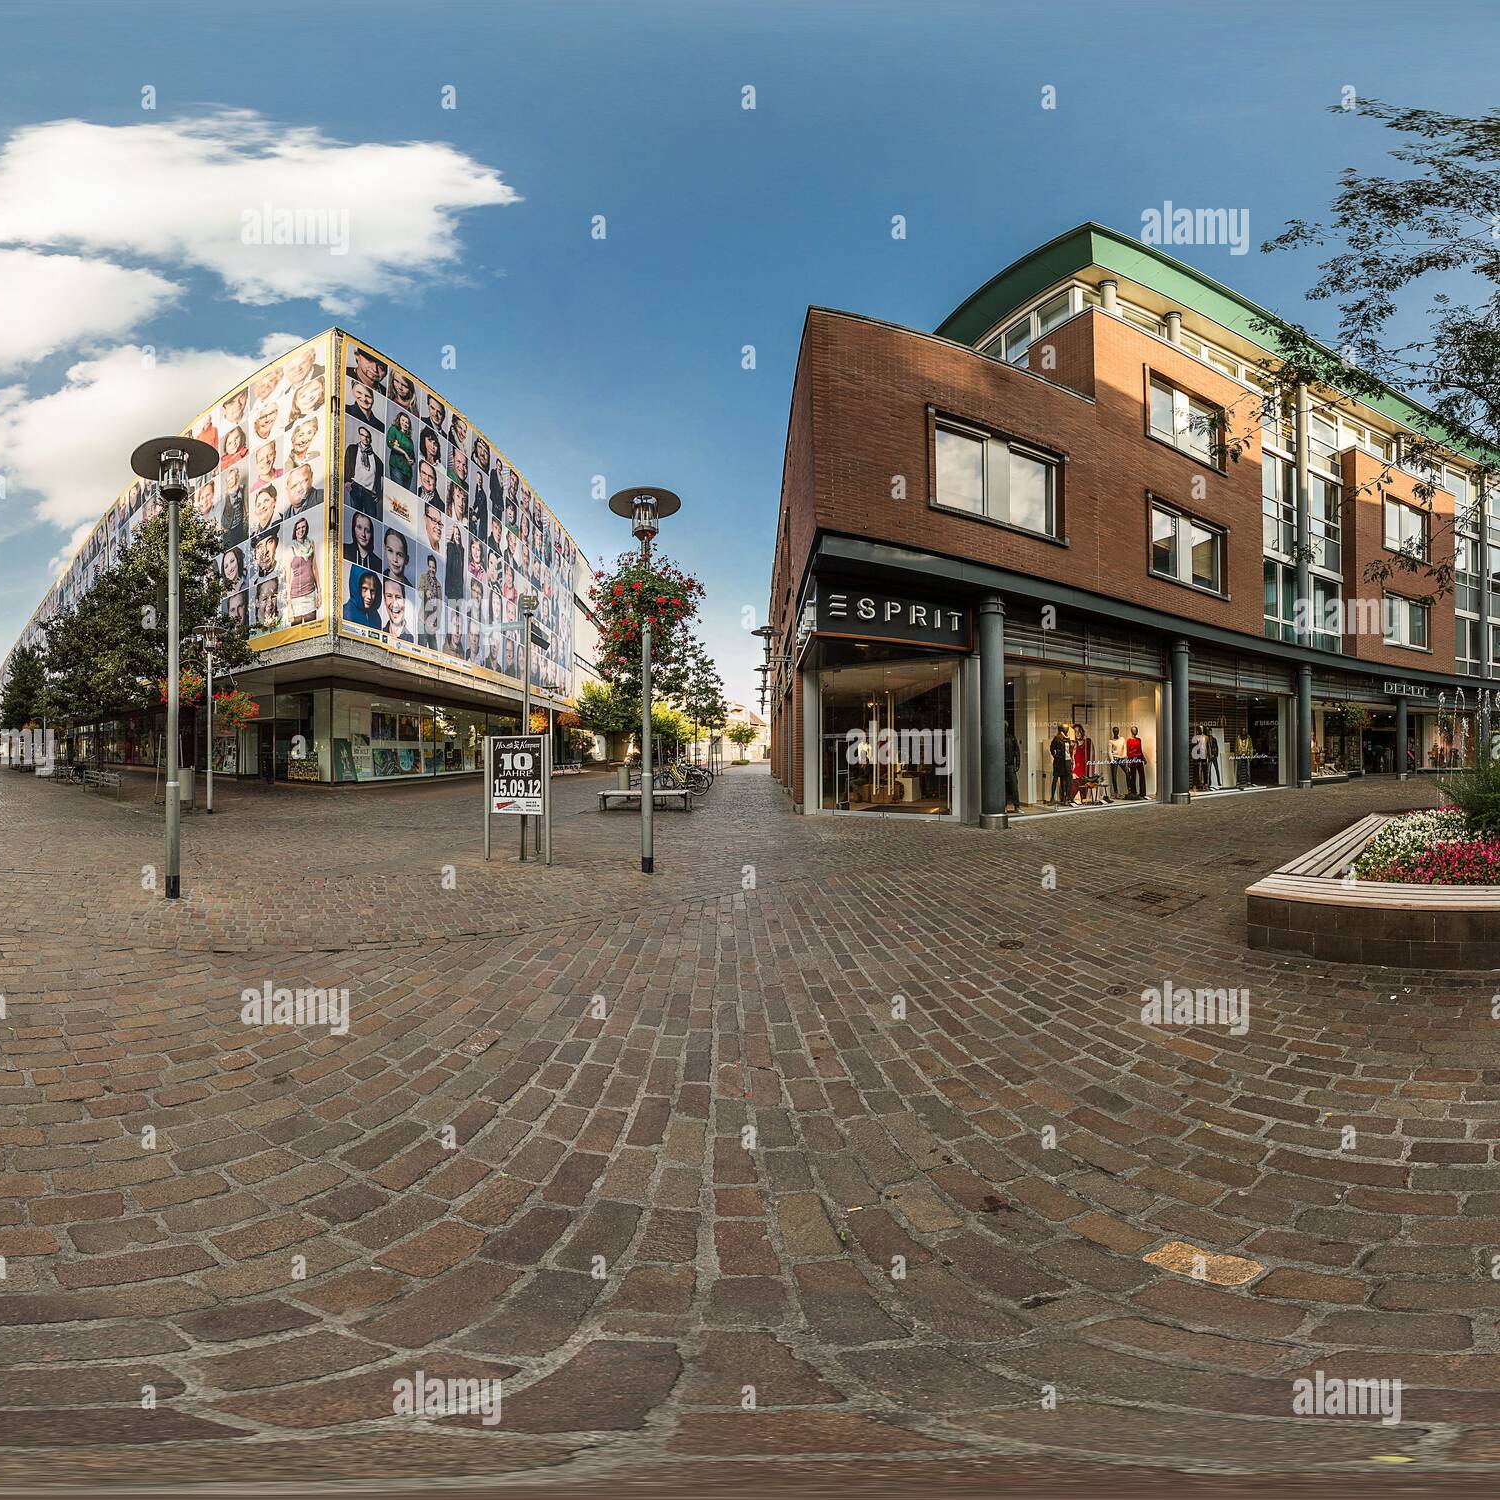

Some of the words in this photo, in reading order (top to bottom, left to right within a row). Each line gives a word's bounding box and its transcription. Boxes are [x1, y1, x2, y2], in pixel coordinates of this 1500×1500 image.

[828, 594, 962, 632] ESPRIT
[1384, 681, 1429, 698] DEPOT
[500, 752, 533, 770] 10
[494, 779, 540, 797] 15.09.12
